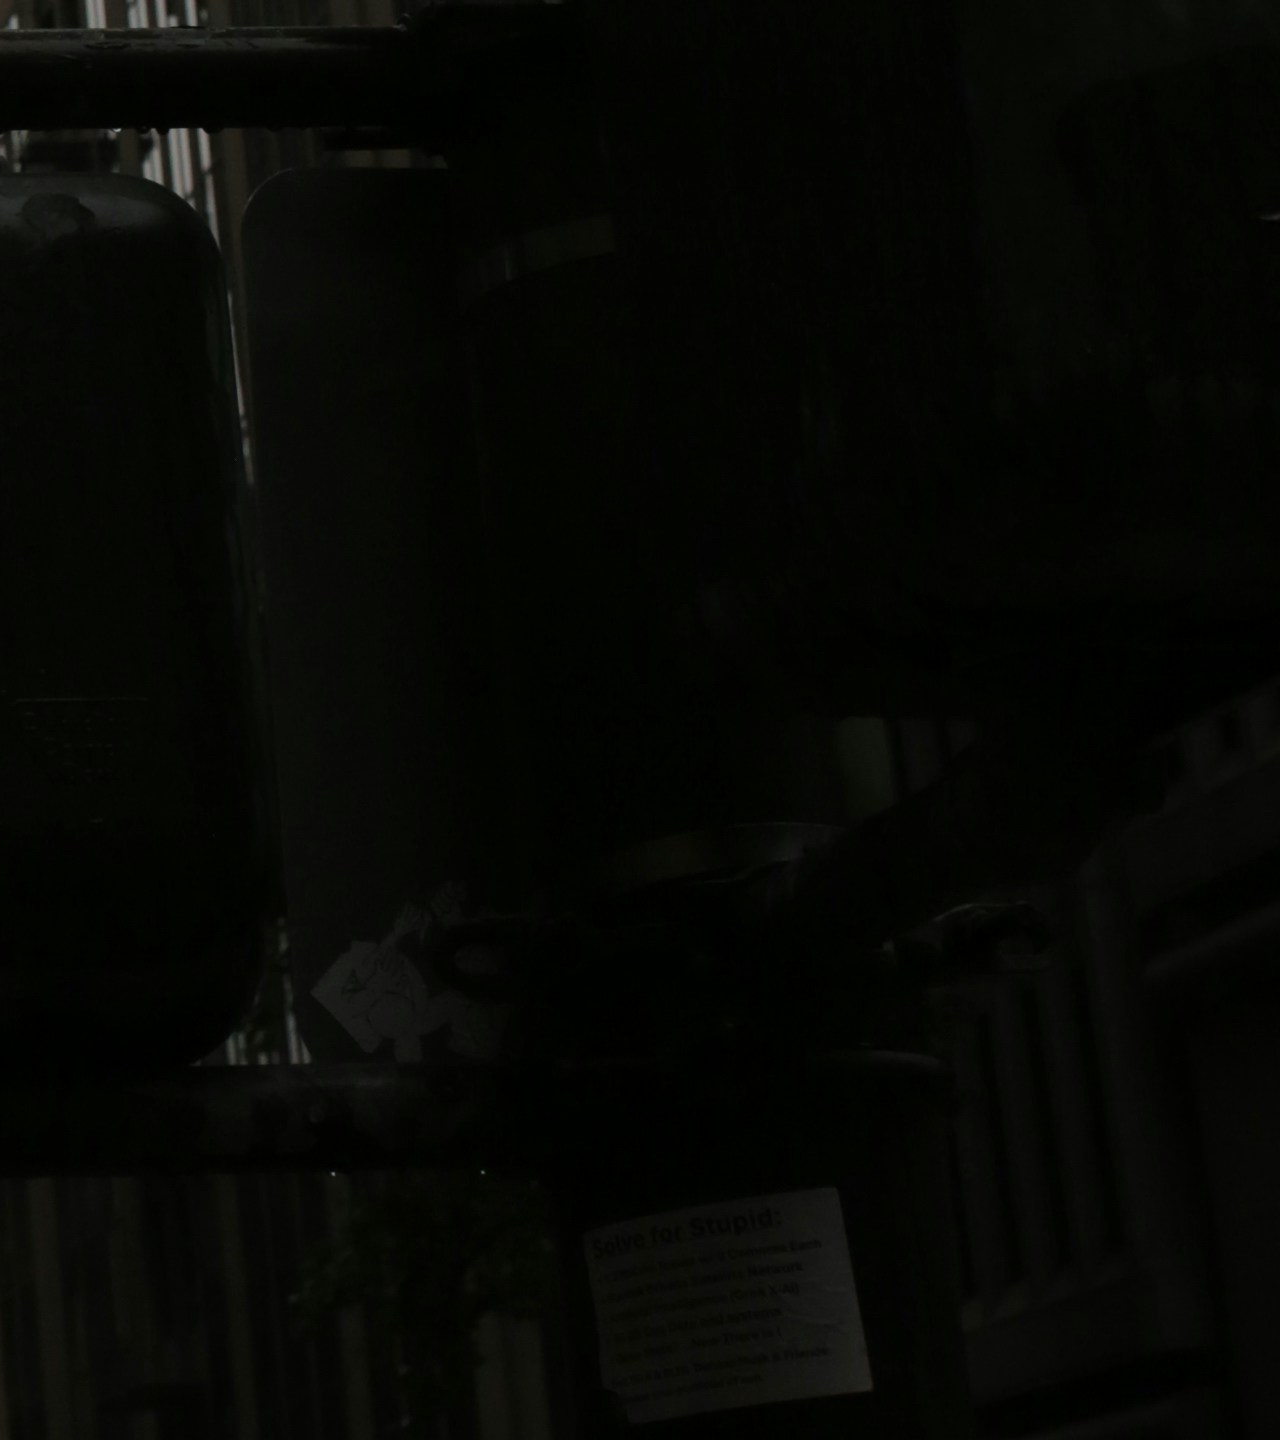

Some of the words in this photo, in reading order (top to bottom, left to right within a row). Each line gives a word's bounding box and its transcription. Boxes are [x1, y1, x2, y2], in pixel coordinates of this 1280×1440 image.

[592, 1232, 646, 1259] Solve
[649, 1222, 683, 1245] for
[690, 1208, 781, 1237] Stupid:
[789, 1238, 822, 1252] Each
[747, 1261, 803, 1277] Network
